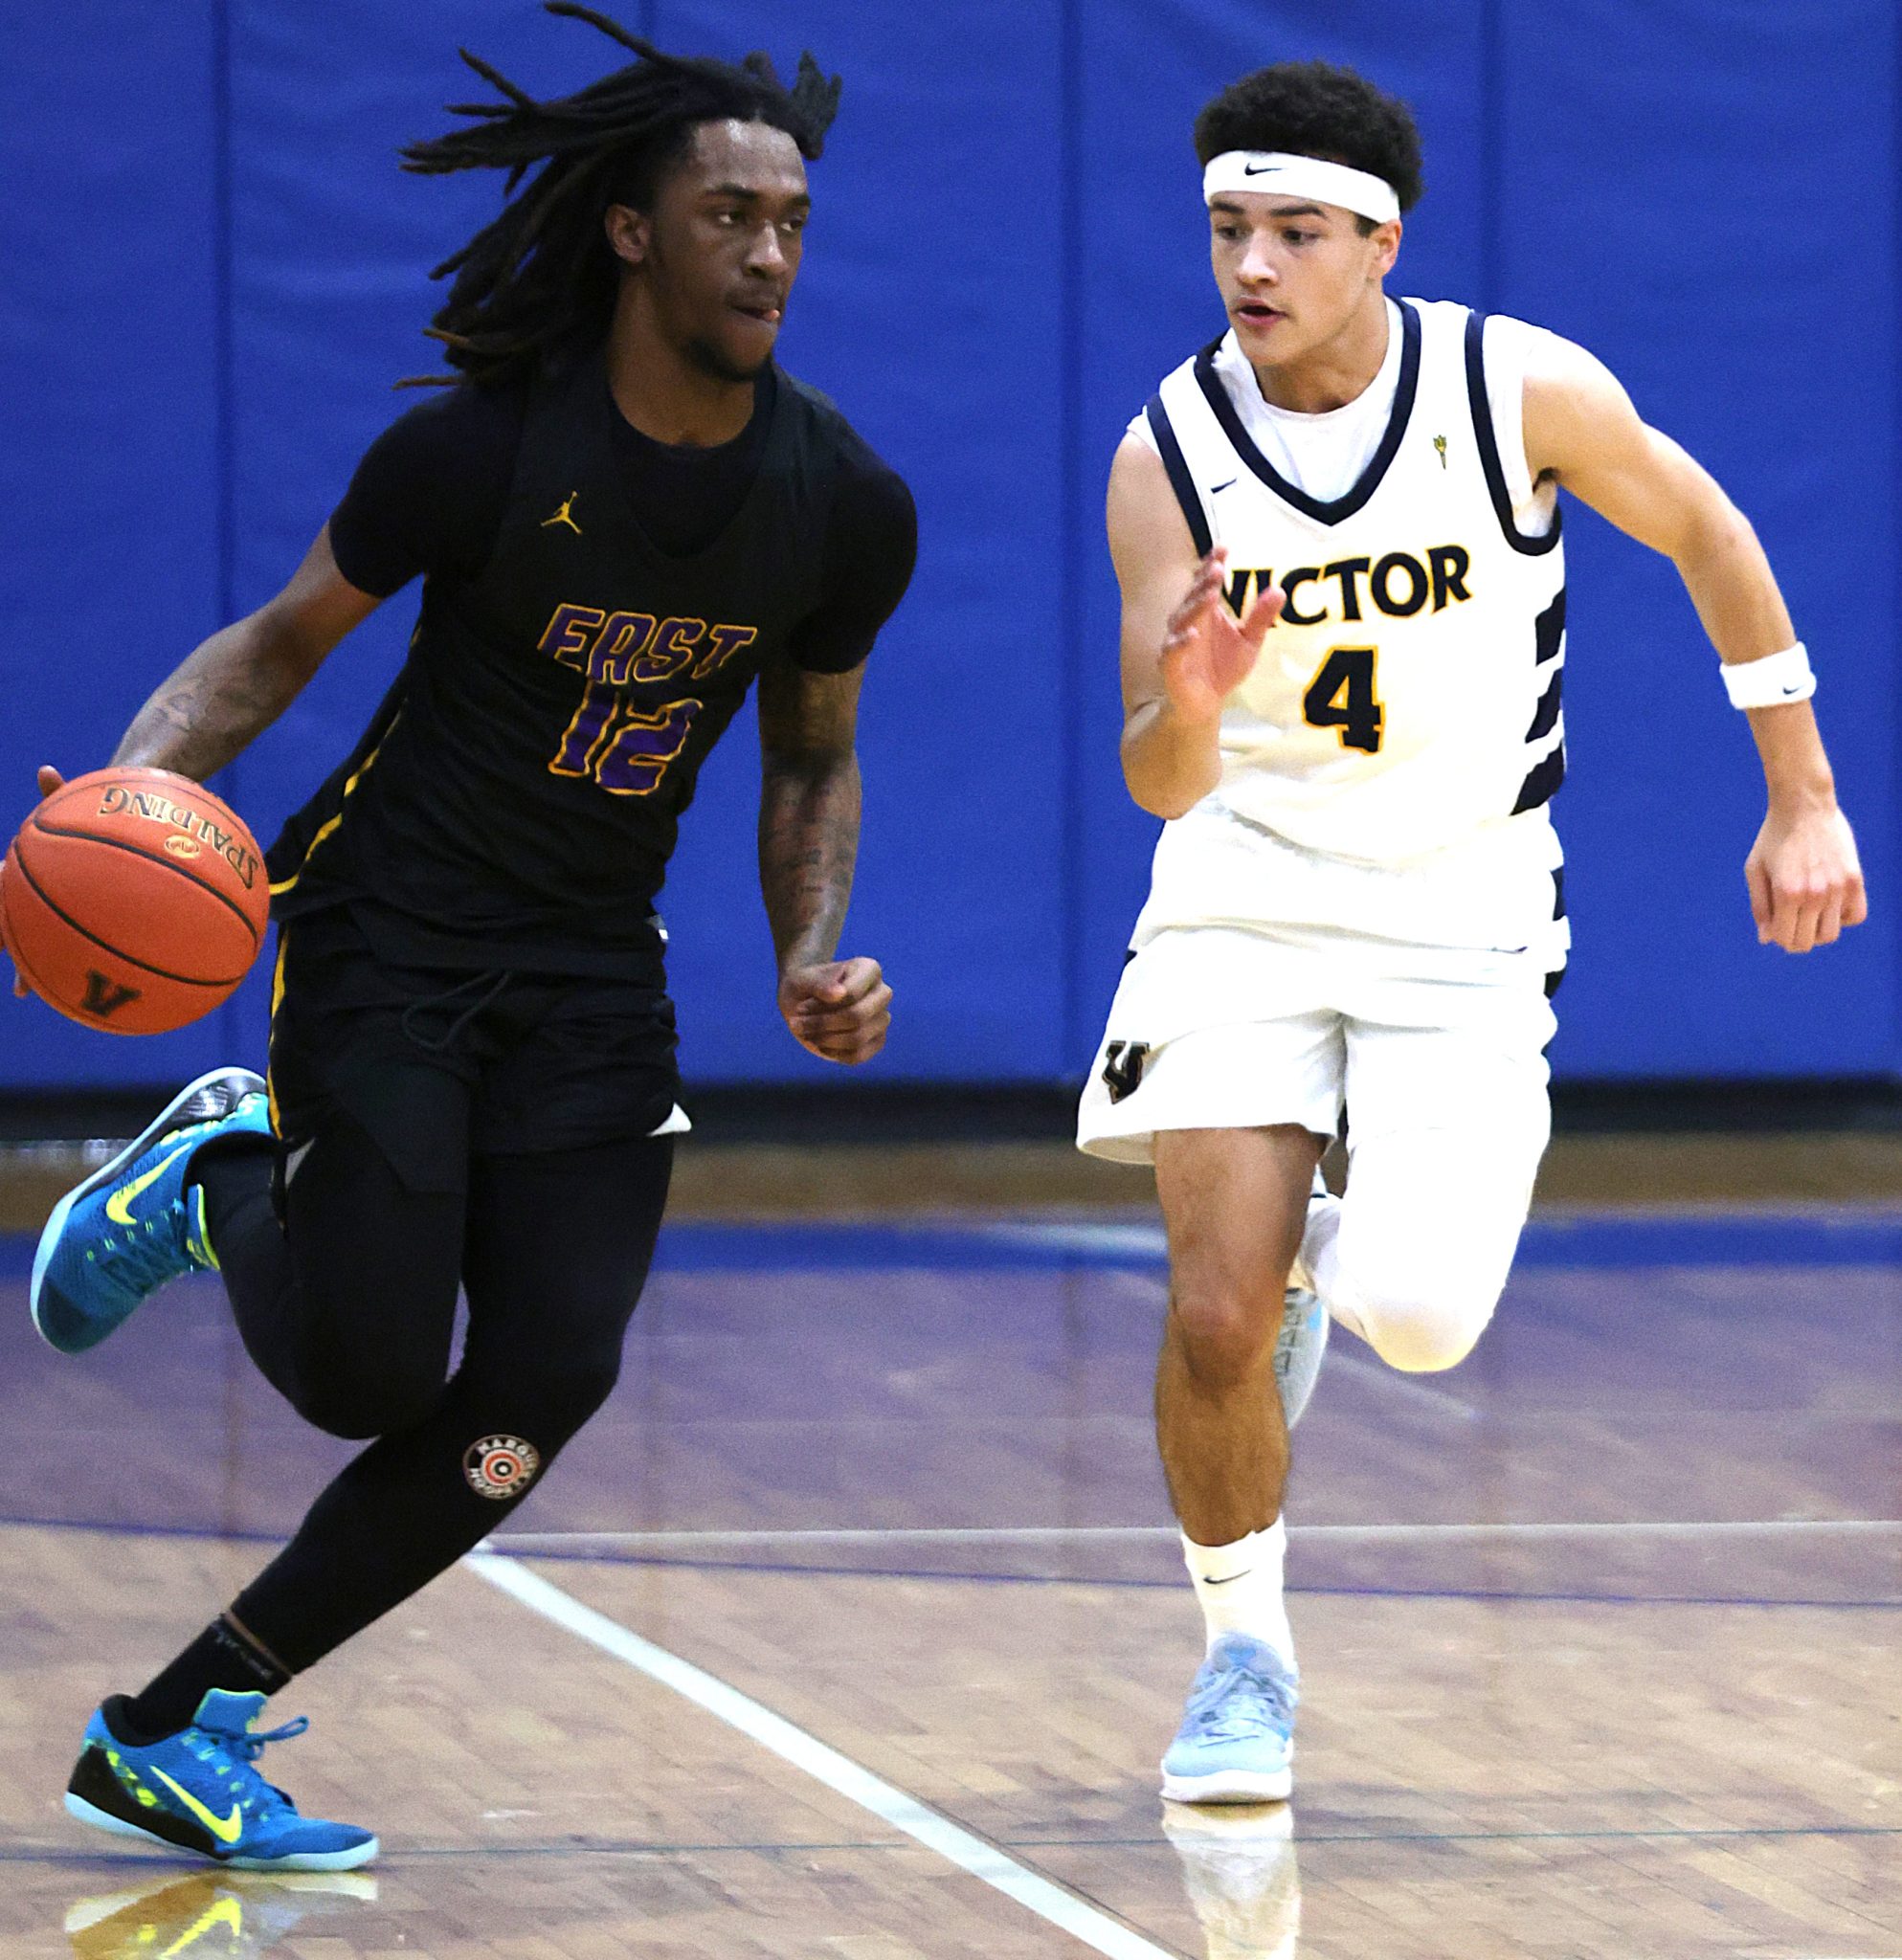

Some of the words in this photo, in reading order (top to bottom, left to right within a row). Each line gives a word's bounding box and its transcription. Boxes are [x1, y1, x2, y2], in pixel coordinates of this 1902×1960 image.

[536, 602, 758, 685] EAST
[548, 680, 705, 796] 12
[1302, 644, 1386, 756] 4
[99, 786, 259, 890] SPALDING
